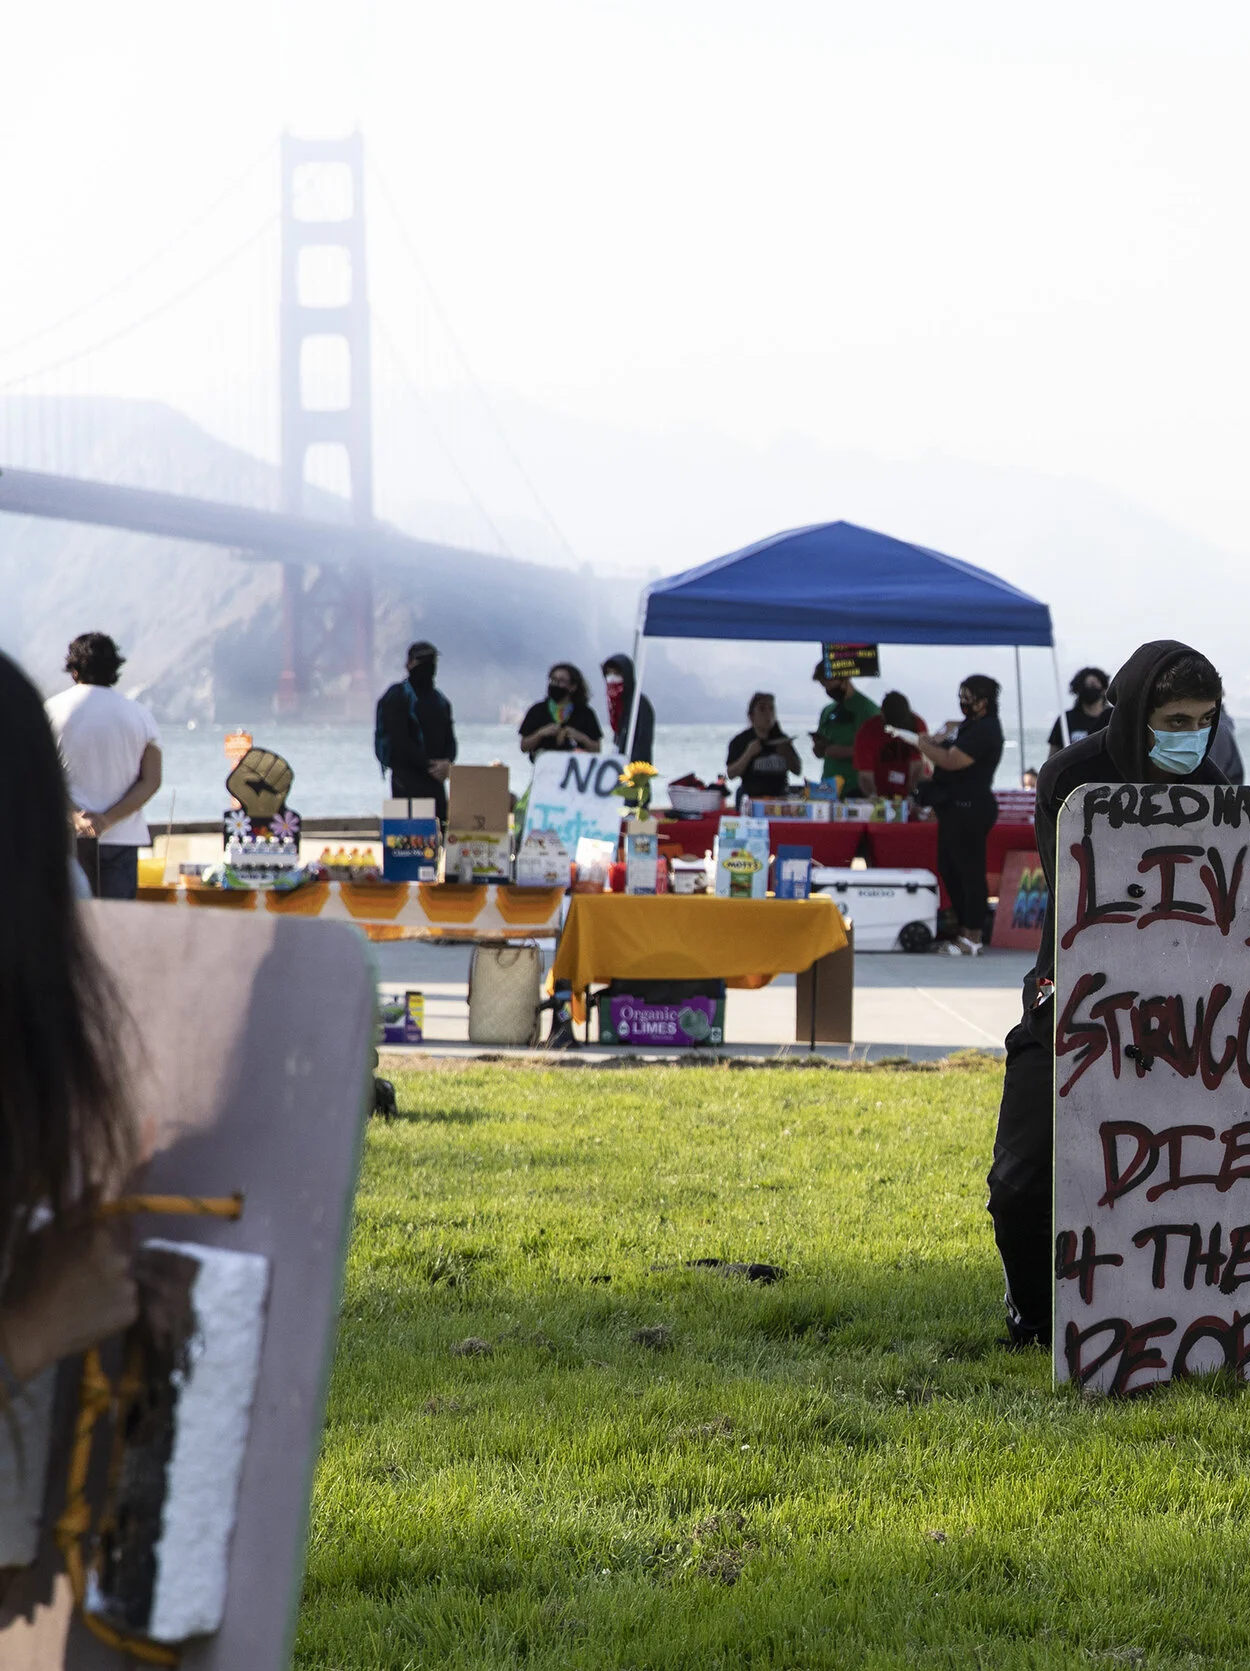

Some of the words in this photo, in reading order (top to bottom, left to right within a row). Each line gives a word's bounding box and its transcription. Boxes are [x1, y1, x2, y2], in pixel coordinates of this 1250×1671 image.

[560, 757, 624, 797] NO
[1084, 784, 1210, 836] FRED
[621, 1005, 678, 1022] Organic
[632, 1021, 677, 1035] LIMES
[1055, 1226, 1123, 1305] 4
